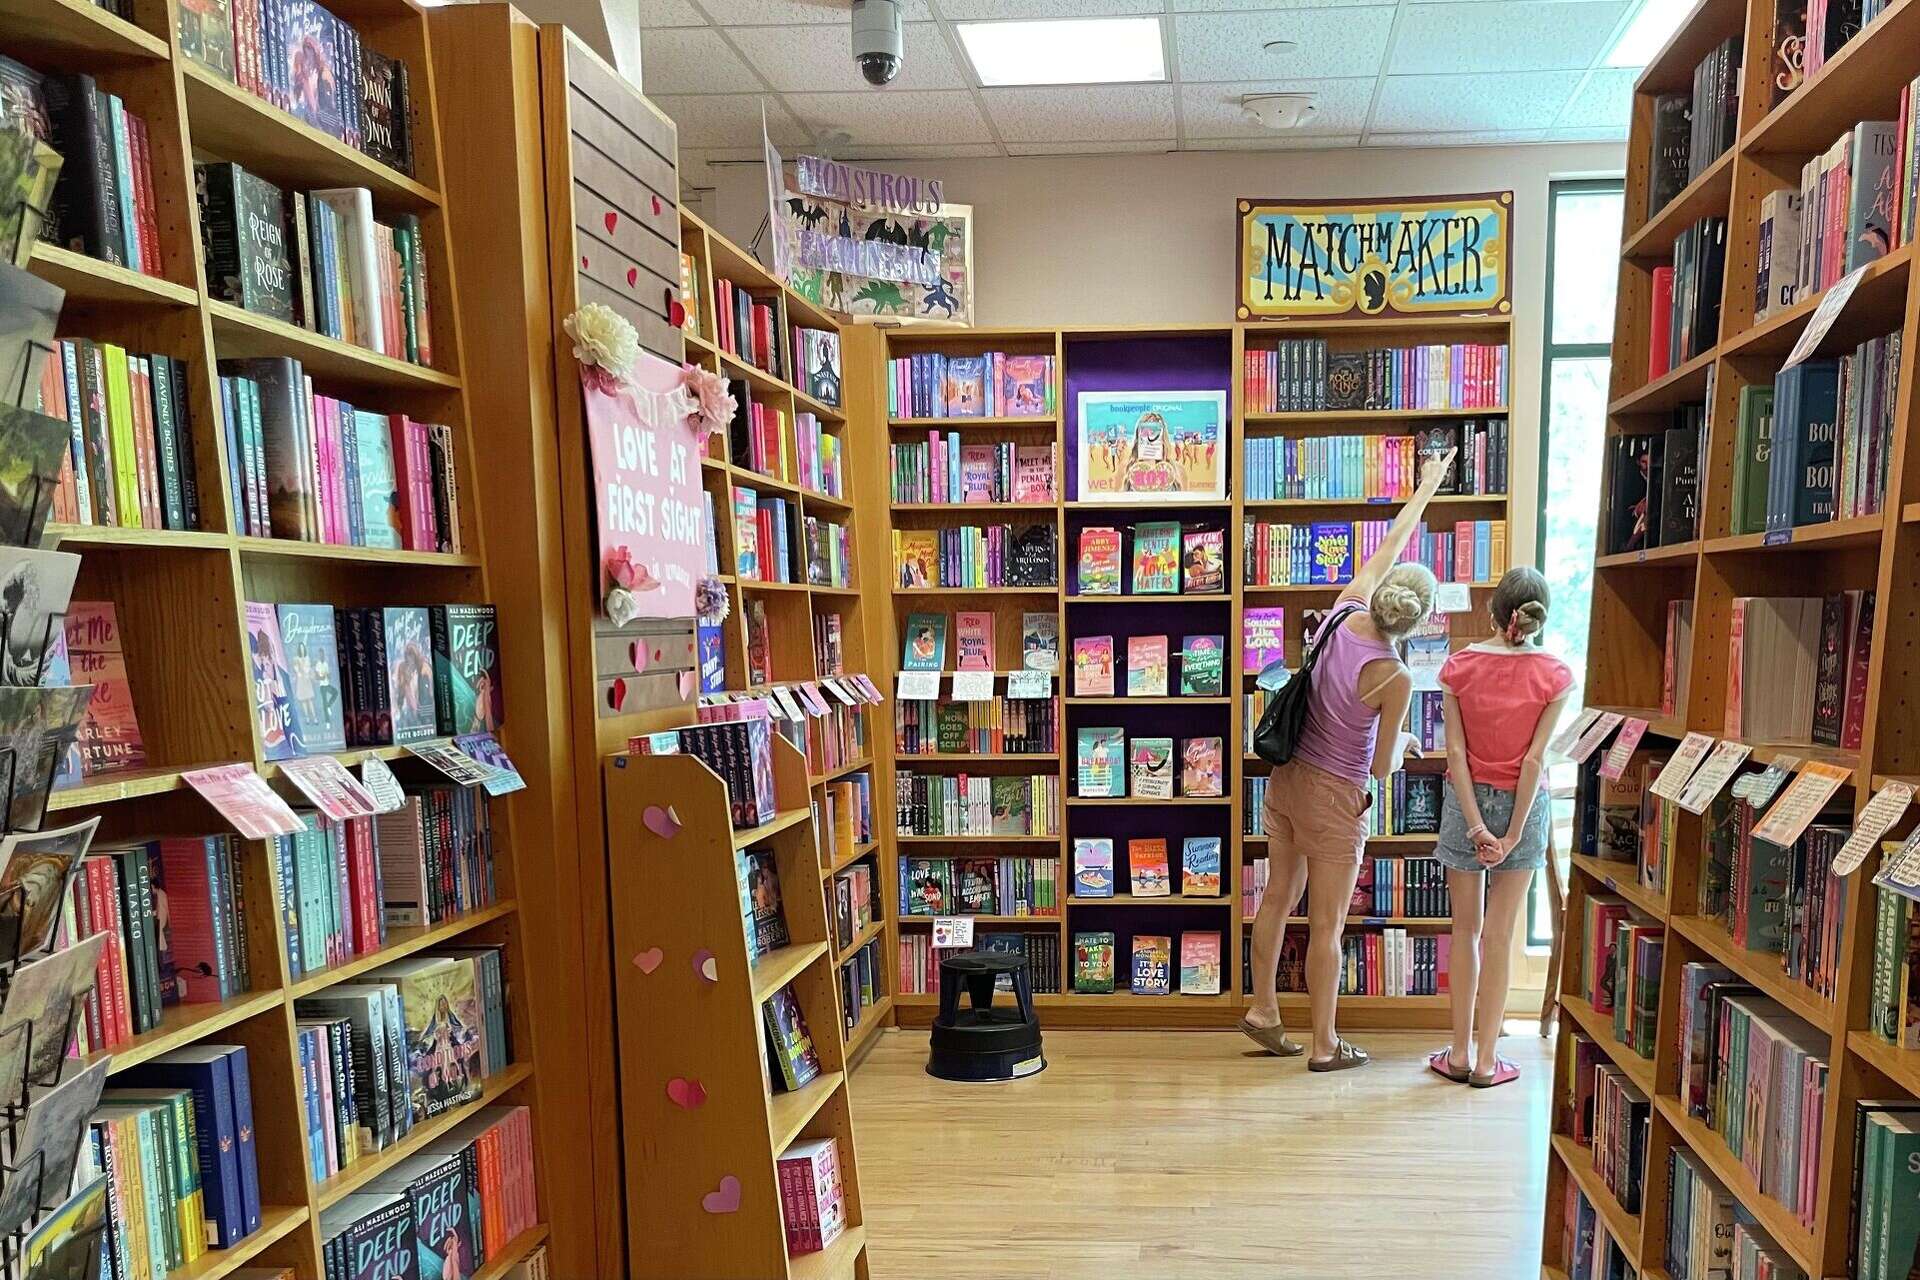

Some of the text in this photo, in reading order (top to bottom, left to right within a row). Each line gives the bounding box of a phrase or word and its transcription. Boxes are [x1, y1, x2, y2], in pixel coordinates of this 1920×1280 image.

[802, 156, 942, 214] MONSTROUS
[262, 203, 268, 217] A
[249, 211, 282, 248] REIGN
[264, 246, 273, 259] OF
[1264, 216, 1483, 301] MATCHMAKER
[254, 255, 285, 293] ROSE
[65, 345, 77, 375] LOVE
[69, 377, 79, 396] YOU
[1110, 403, 1150, 413] bookpeople
[157, 366, 175, 473] HEAVENLY BODIES
[613, 423, 688, 487] LOVE AT
[1019, 457, 1040, 468] MEET
[244, 443, 259, 516] ARROGANT DEVIL
[257, 446, 271, 519] ARROGANT DEVIL
[965, 472, 990, 482] ROYAL
[1021, 473, 1053, 484] PENALTY
[1088, 477, 1114, 490] wet
[1030, 484, 1046, 493] BOX
[607, 473, 701, 547] FIRST SIGHT
[1319, 534, 1349, 547] Novel
[1320, 544, 1346, 556] Love
[1315, 552, 1347, 567] Story
[1136, 576, 1173, 590] HATERS
[460, 607, 494, 615] HAZELWOOD
[88, 615, 113, 646] Me
[283, 611, 334, 644] Daydream
[964, 617, 980, 628] RED
[1243, 617, 1281, 628] Sounds
[453, 621, 495, 650] DEEP
[961, 637, 985, 646] ROYAL
[1245, 636, 1280, 648] Love
[1252, 628, 1273, 638] Like
[963, 648, 983, 656] BLUE
[81, 652, 107, 673] the
[463, 648, 495, 679] END
[907, 660, 939, 668] PAIRING
[261, 702, 292, 733] LOVE
[945, 714, 967, 722] NORA
[939, 723, 963, 731] GOES
[942, 732, 959, 740] OFF
[83, 742, 134, 760] RTUNE
[939, 741, 970, 749] SCRIPT
[1610, 784, 1640, 793] YOUR
[338, 825, 348, 884] PANSIES
[1185, 841, 1217, 857] Summer
[1186, 852, 1219, 870] Reading
[911, 868, 930, 879] LOVE
[964, 877, 983, 888] TRUTH
[138, 865, 151, 918] CHAOS
[278, 874, 287, 911] MATERIAL
[969, 892, 992, 904] EMBER
[128, 883, 141, 939] FIASCO
[758, 921, 780, 936] KATEE
[757, 929, 786, 947] ROBERT
[1873, 909, 1885, 998] ABOUT AFTER
[1882, 906, 1898, 1005] ABOUT AFTER
[1080, 960, 1109, 968] TO YOU
[1137, 968, 1164, 977] LOVE
[1133, 977, 1168, 988] STORY
[334, 1025, 346, 1100] One on One
[345, 1022, 356, 1095] One on One
[426, 1089, 473, 1115] JESSA HASTINGS
[175, 1102, 187, 1144] JACKPOT
[424, 1159, 462, 1183] HAZELWOOD
[103, 1144, 122, 1260] ROYAL REBEL JENNY
[418, 1173, 462, 1226] DEEP
[353, 1202, 411, 1234] ALI HAZELWOOD
[430, 1202, 462, 1248] END
[358, 1216, 411, 1276] DEEP
[373, 1248, 411, 1280] END
